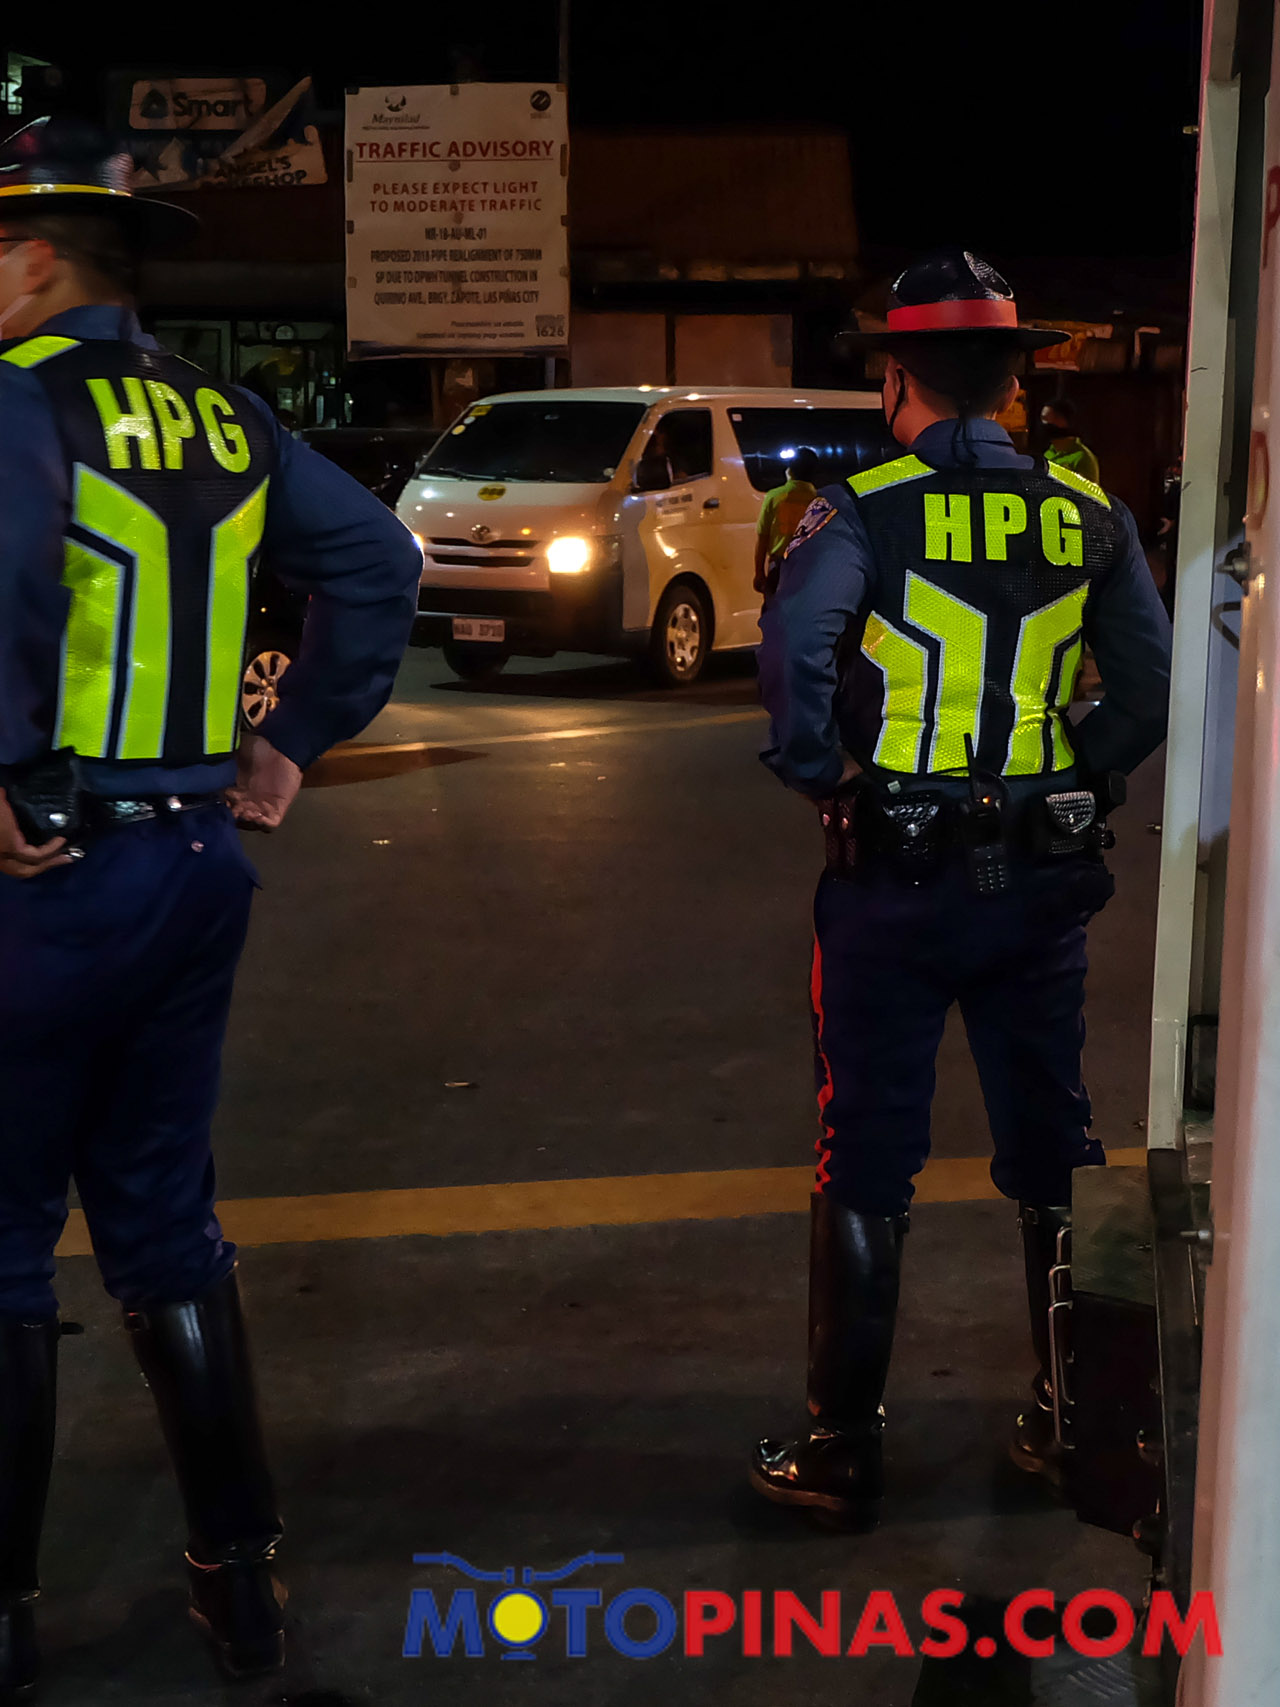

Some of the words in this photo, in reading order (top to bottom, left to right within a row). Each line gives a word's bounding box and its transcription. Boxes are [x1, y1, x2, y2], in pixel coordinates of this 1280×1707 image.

[356, 142, 441, 158] TRAFFIC
[447, 140, 554, 158] ADVISORY
[373, 182, 428, 195] PLEASE
[433, 181, 489, 195] EXPECT
[493, 181, 538, 194] LIGHT
[370, 200, 389, 213] TO
[393, 199, 475, 213] MODERATE
[480, 199, 542, 212] TRAFFIC
[403, 271, 413, 283] TO
[470, 270, 528, 282] CONSTRUCTION
[483, 291, 497, 304] LAS
[522, 291, 539, 303] CITY
[86, 377, 251, 473] HPG
[924, 492, 1084, 567] HPG
